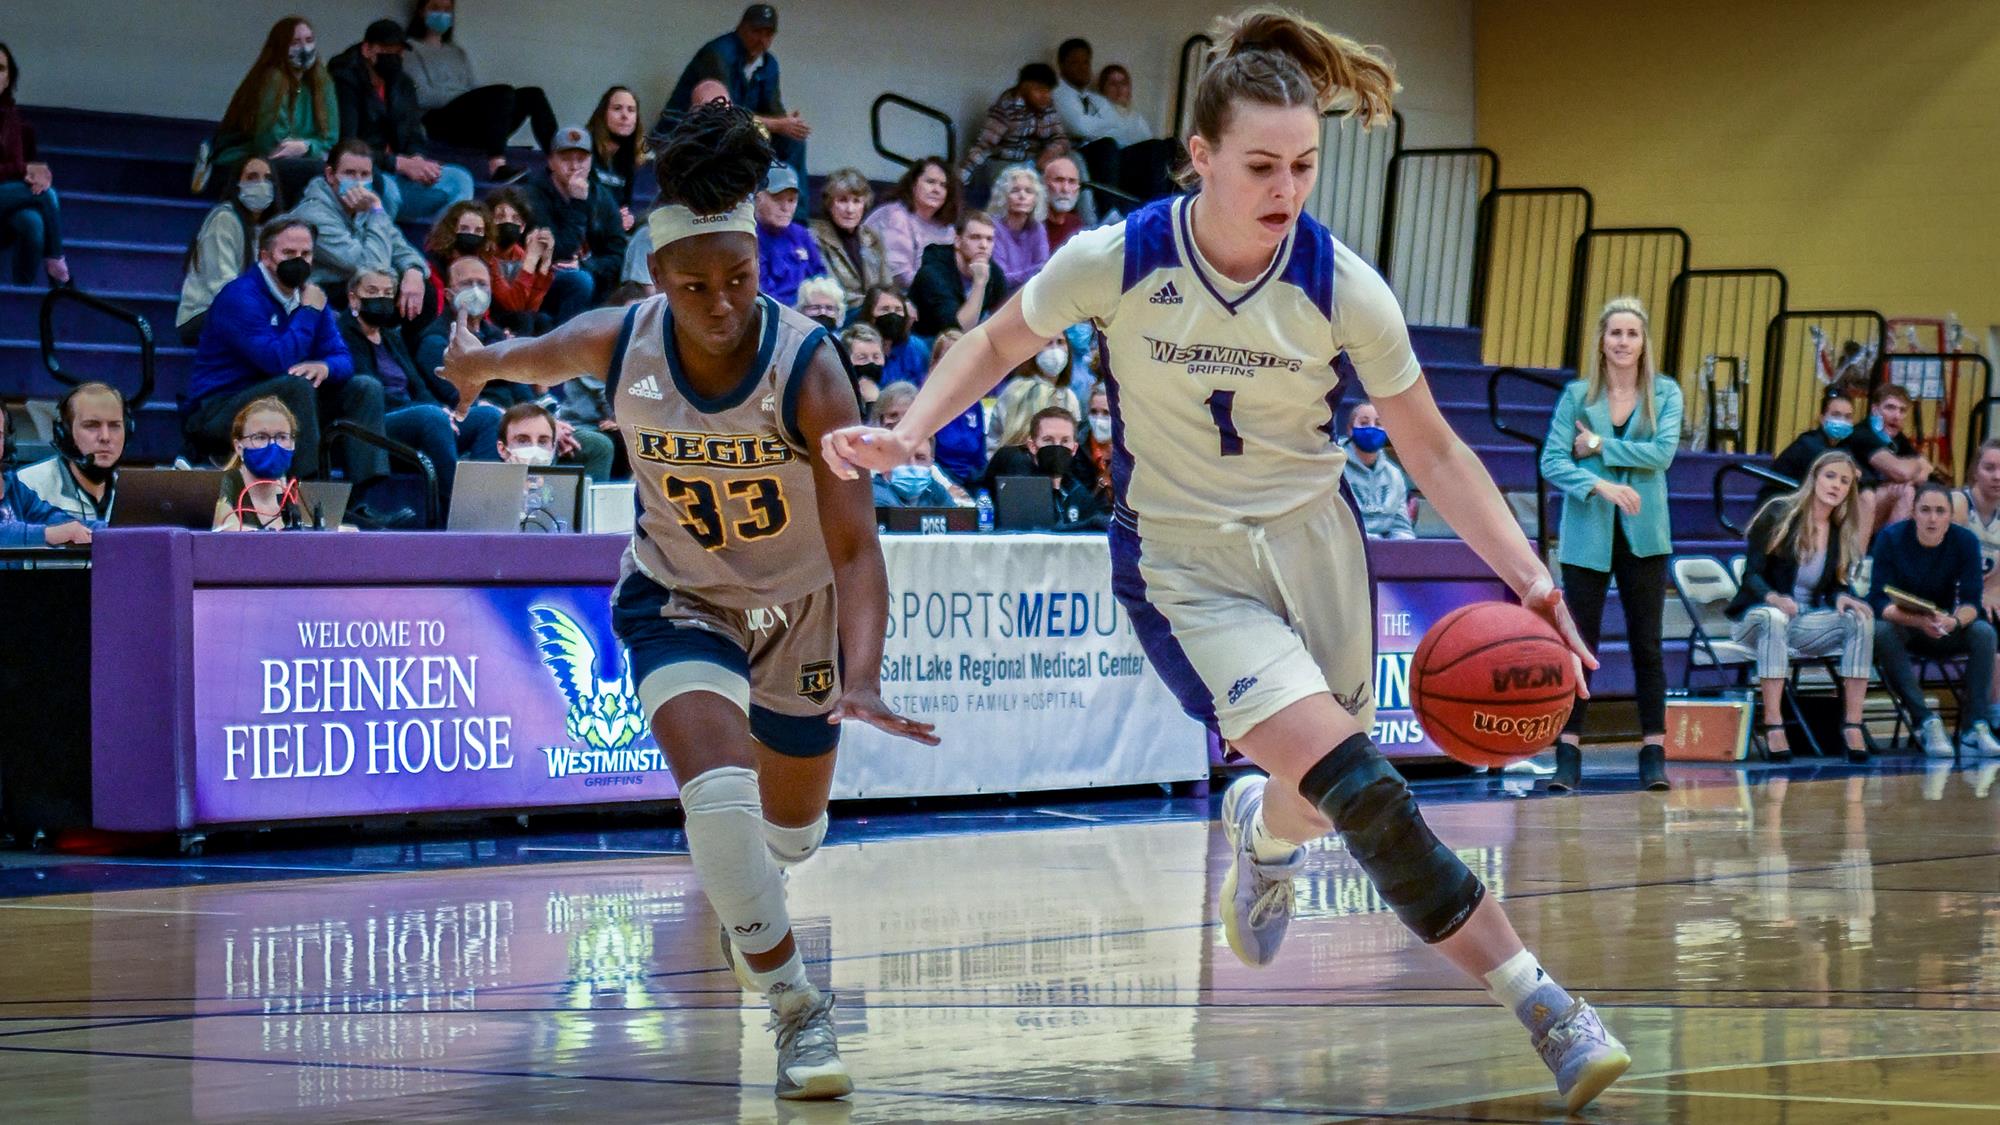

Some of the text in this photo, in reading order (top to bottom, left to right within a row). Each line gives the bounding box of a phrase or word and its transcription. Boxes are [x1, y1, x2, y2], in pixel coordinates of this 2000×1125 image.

[692, 213, 729, 225] adidas
[1149, 294, 1184, 305] adidas
[1187, 363, 1255, 378] GRIFFINS
[628, 387, 663, 401] adidas
[1204, 389, 1244, 457] 1
[636, 428, 795, 467] REGIS
[662, 471, 792, 553] 33
[297, 620, 446, 649] WELCOME TO
[1382, 613, 1411, 636] THE
[881, 650, 1146, 687] Salt Lake Regional Medical Center
[260, 654, 479, 715] BEHNKEN
[892, 690, 1088, 715] STEWARD FAMILY HOSPITAL
[222, 716, 515, 782] FIELD HOUSE
[584, 774, 644, 788] GRIFFINS
